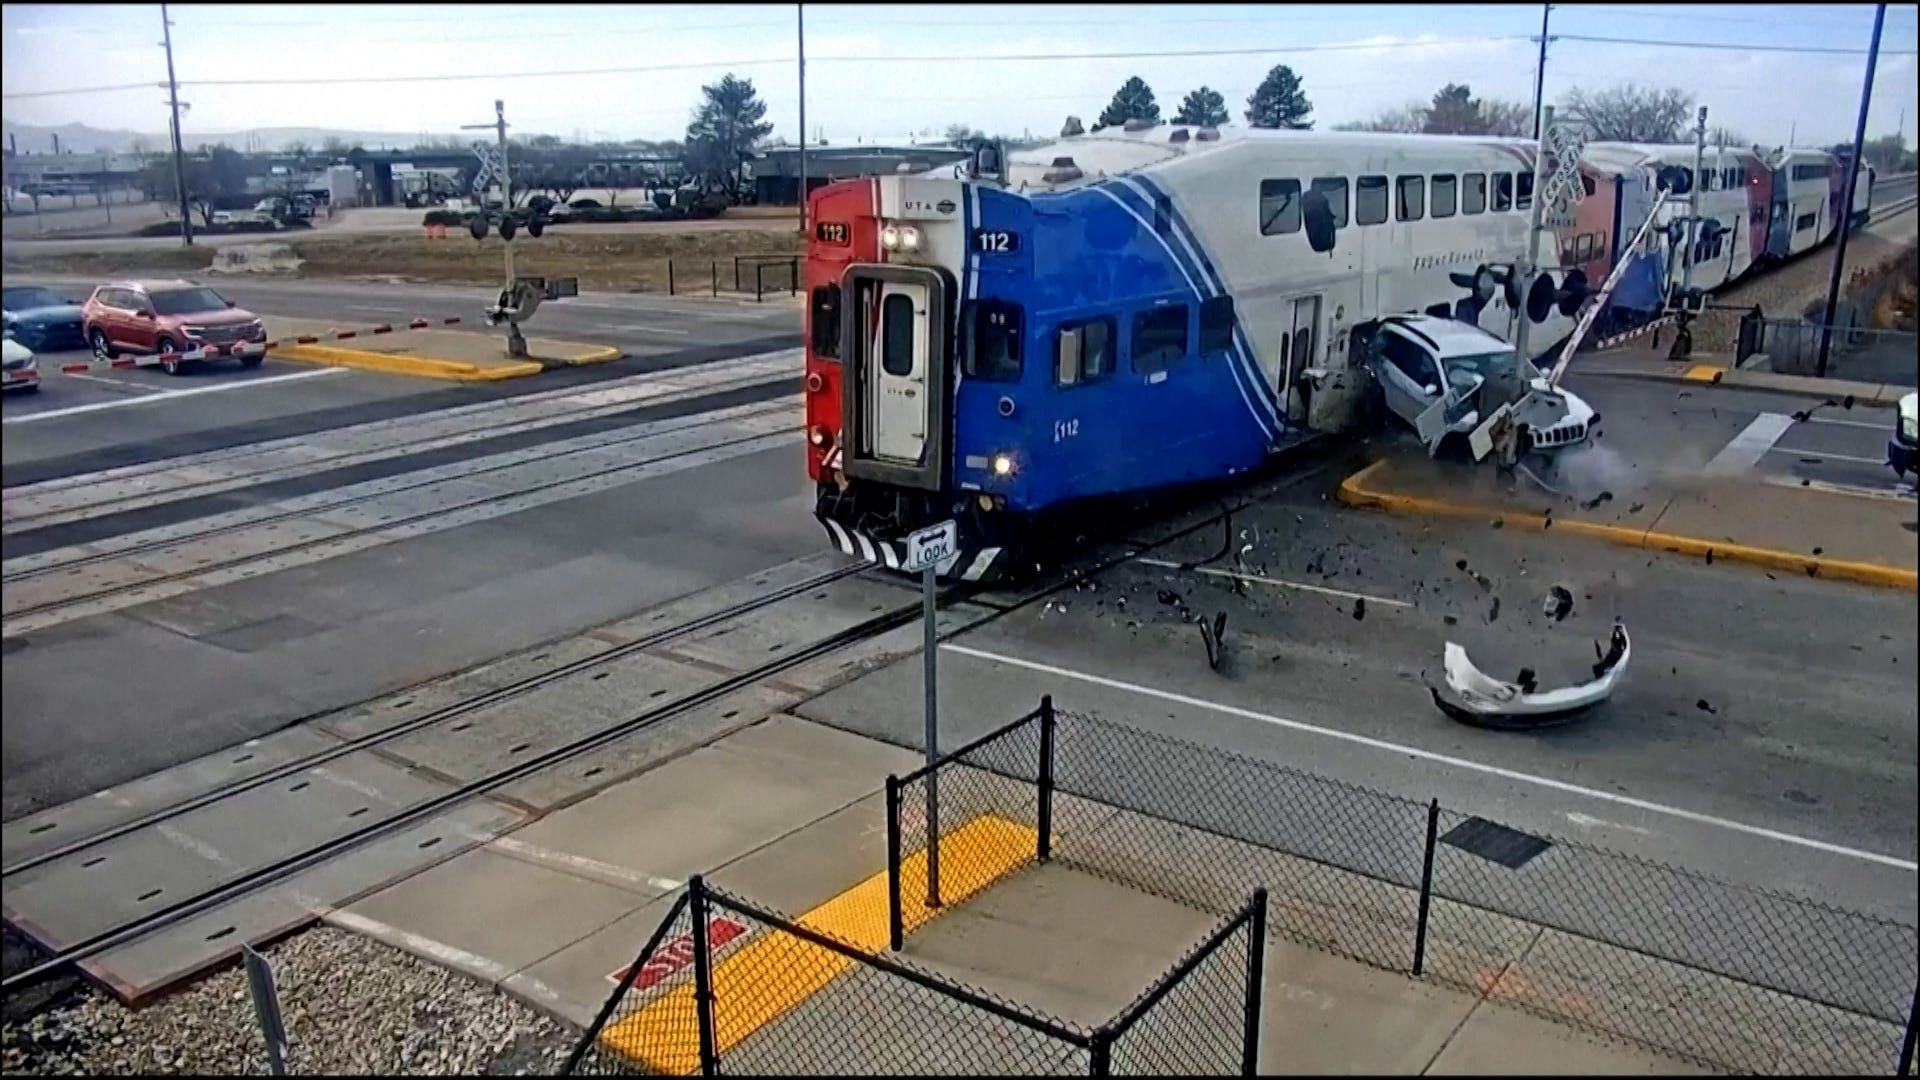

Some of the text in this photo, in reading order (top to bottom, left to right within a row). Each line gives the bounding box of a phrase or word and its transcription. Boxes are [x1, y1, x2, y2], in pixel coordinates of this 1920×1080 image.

[822, 225, 844, 242] 112
[979, 232, 1009, 251] 112
[1060, 419, 1079, 438] 112
[916, 541, 948, 565] LOOK
